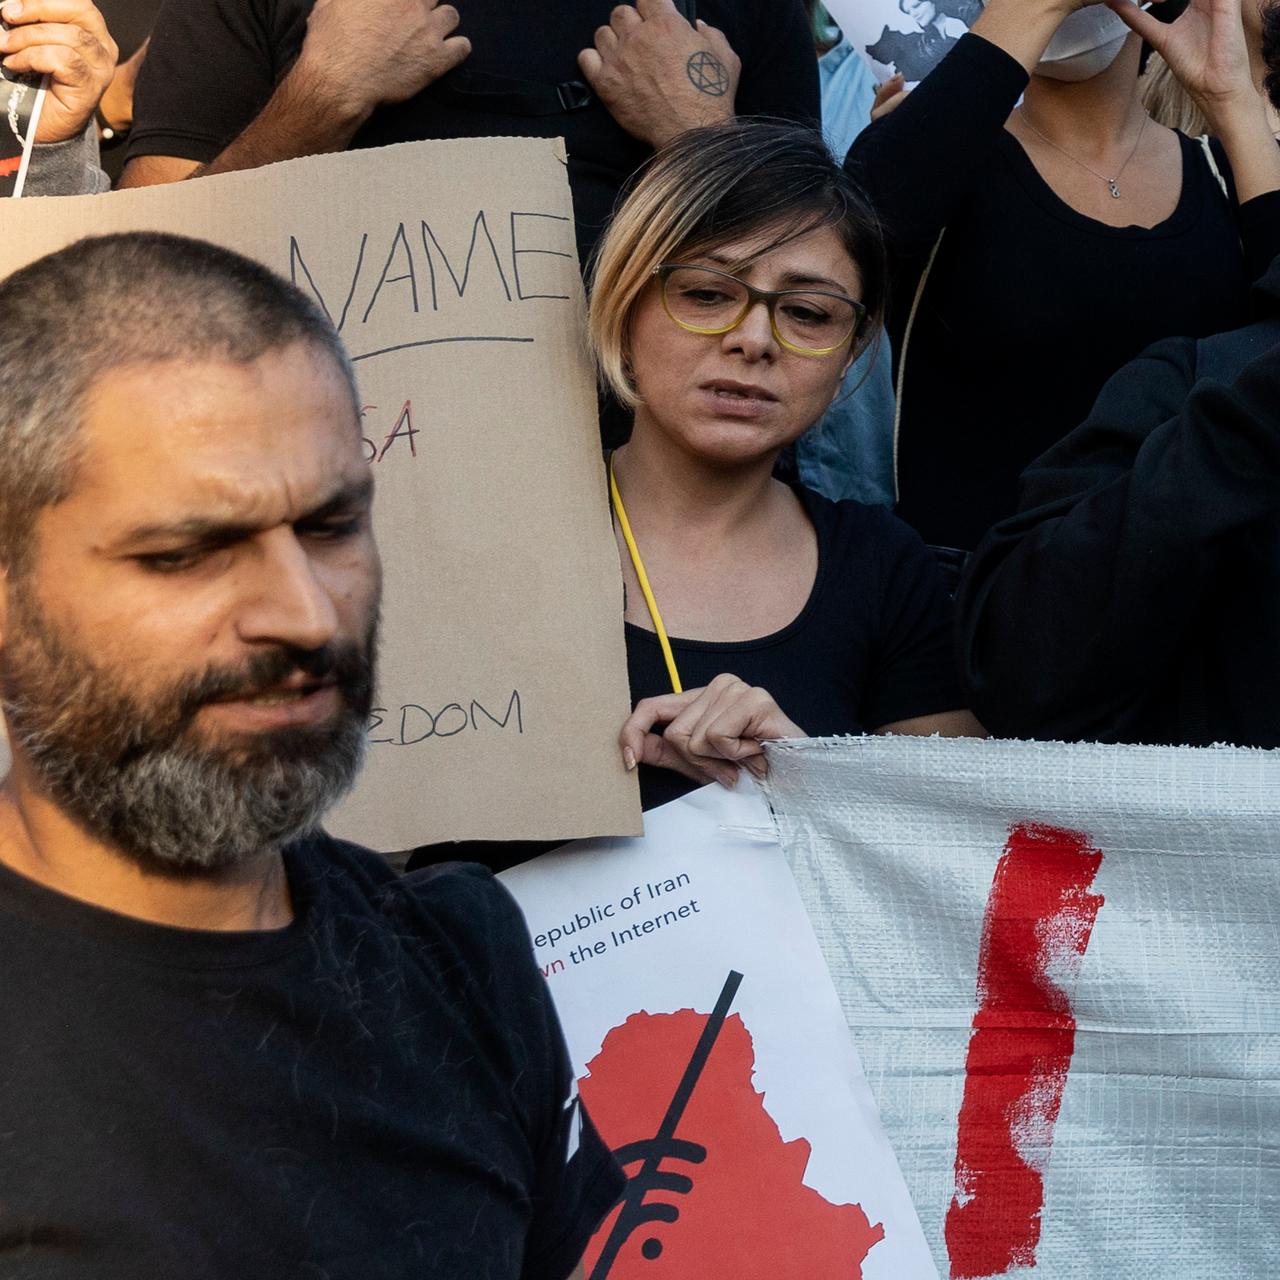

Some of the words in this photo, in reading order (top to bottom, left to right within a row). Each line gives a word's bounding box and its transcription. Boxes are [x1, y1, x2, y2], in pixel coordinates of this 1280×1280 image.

[289, 209, 573, 332] NAME
[534, 904, 616, 948] epublic
[620, 886, 641, 910] of
[646, 872, 690, 899] Iran
[569, 941, 607, 965] the
[611, 899, 701, 947] Internet
